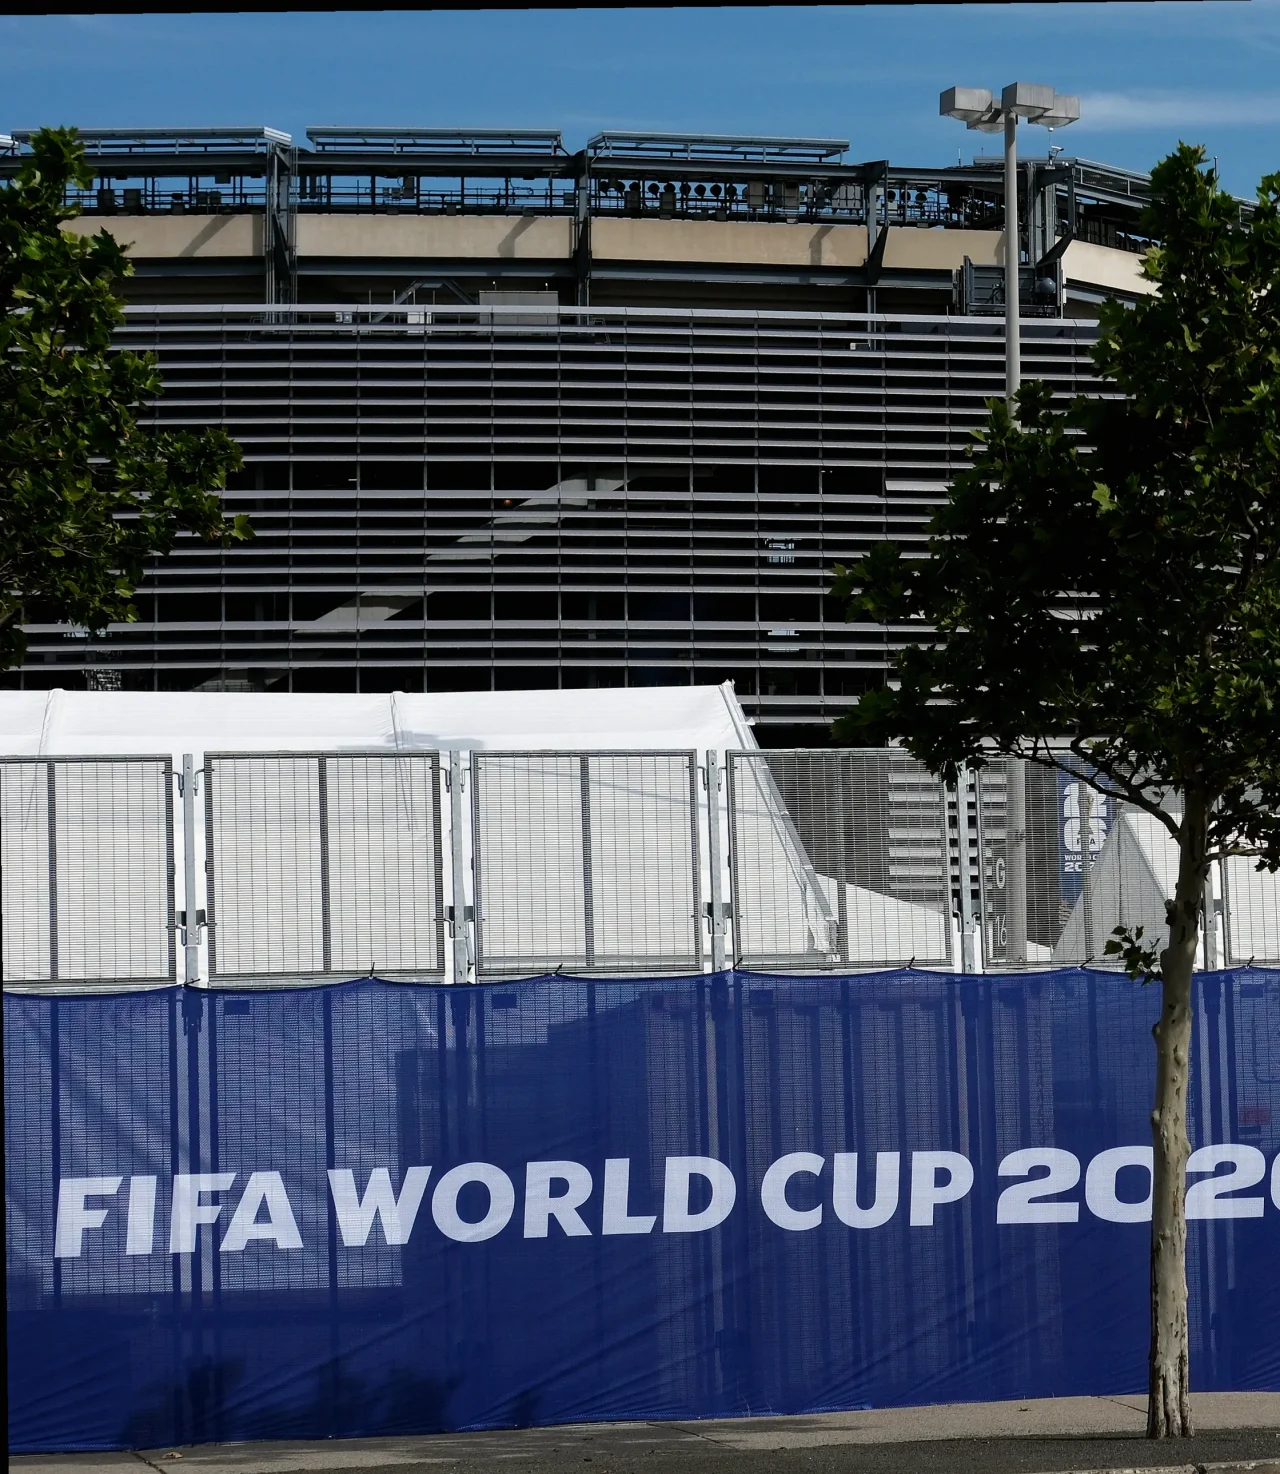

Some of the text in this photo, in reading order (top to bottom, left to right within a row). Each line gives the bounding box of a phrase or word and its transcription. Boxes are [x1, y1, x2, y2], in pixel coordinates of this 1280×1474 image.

[54, 1170, 304, 1258] FIFA
[326, 1156, 737, 1247] WORLD
[760, 1151, 974, 1231] CUP
